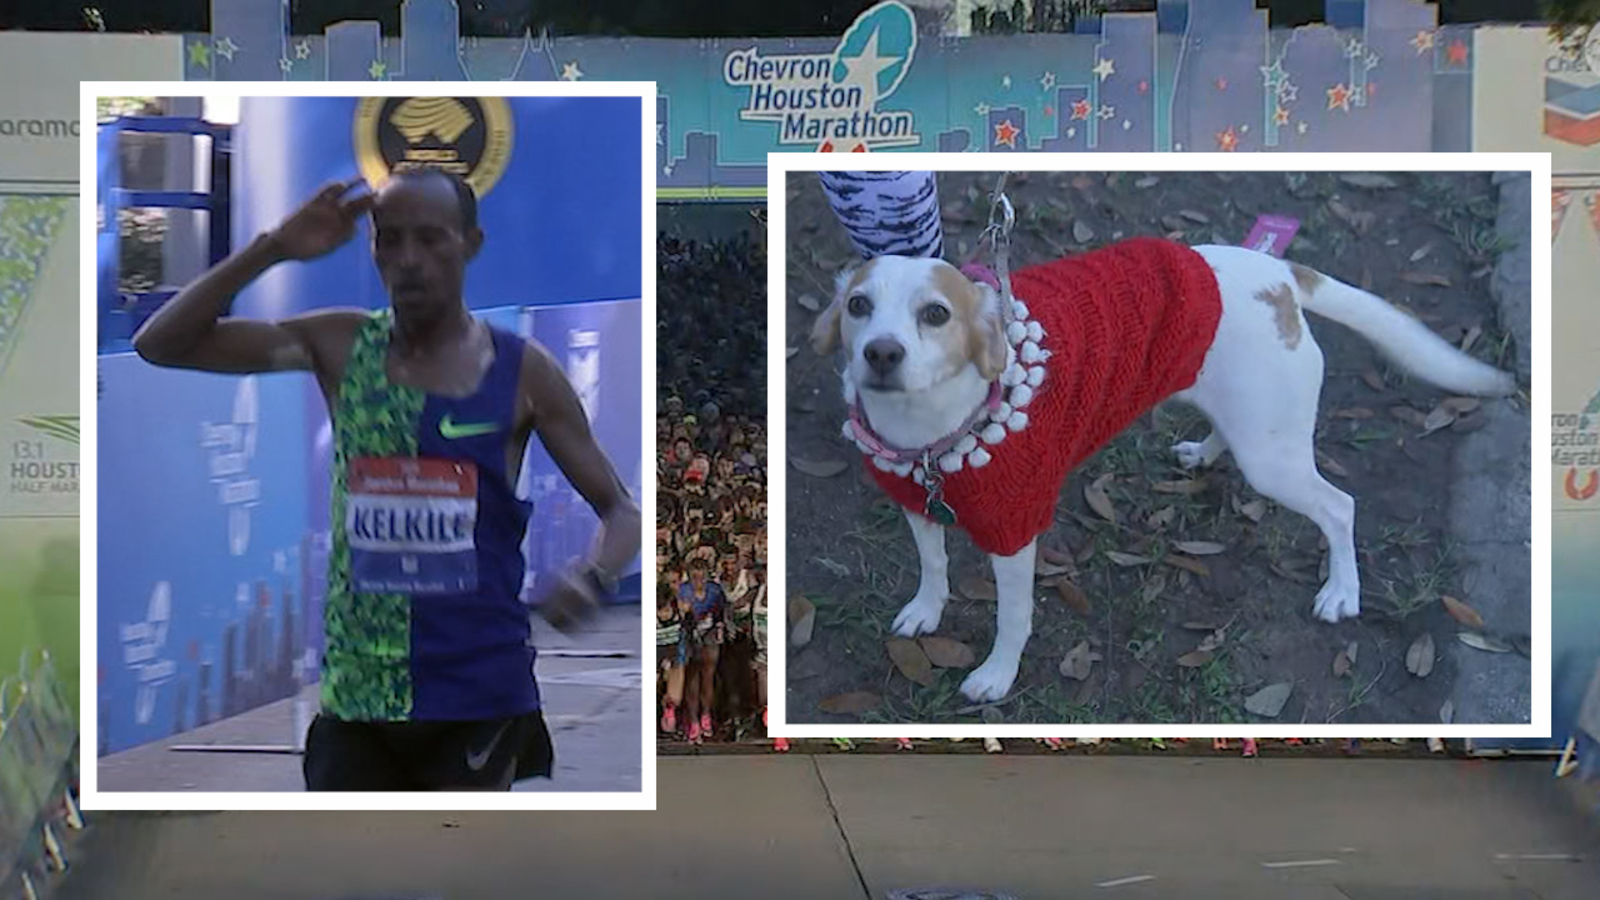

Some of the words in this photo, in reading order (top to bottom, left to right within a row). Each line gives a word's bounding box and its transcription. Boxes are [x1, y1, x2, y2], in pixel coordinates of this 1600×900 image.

[728, 54, 831, 82] Chevron
[753, 84, 862, 111] Houston
[784, 111, 911, 139] Marathon
